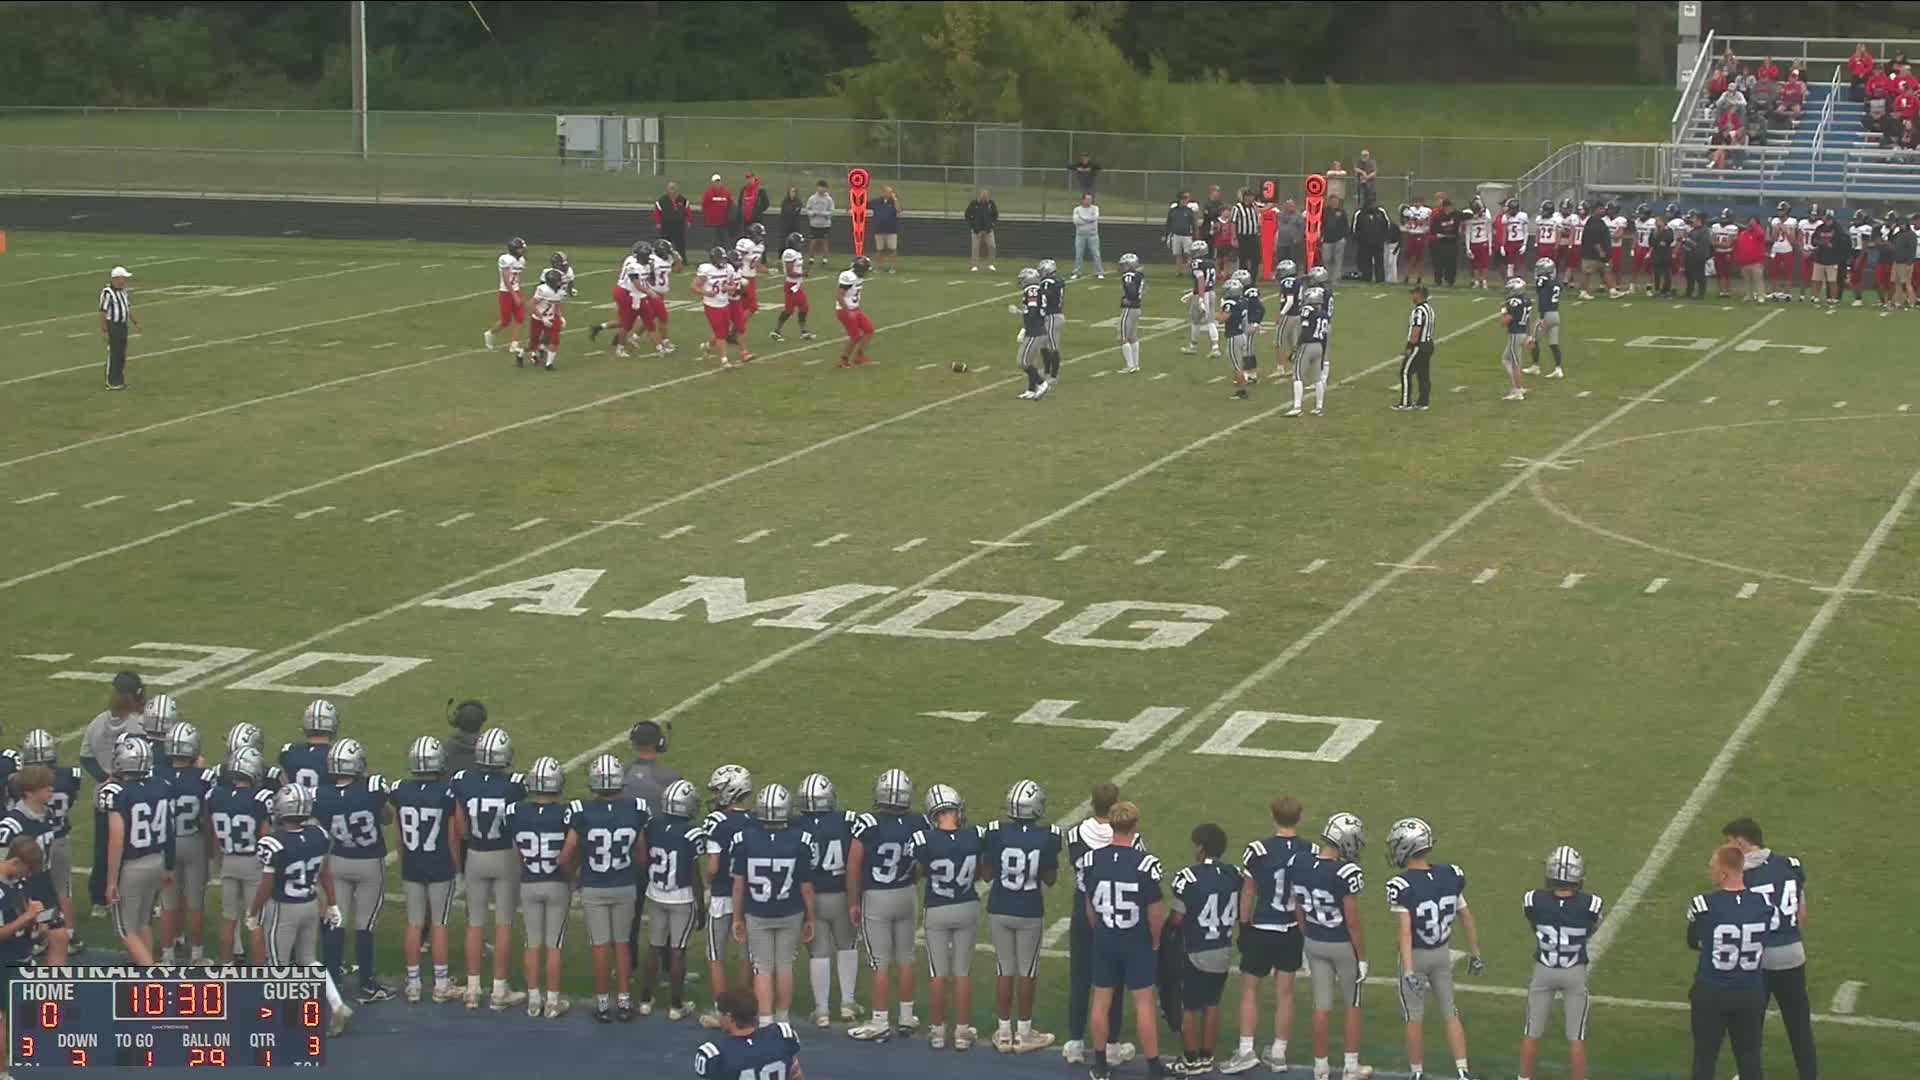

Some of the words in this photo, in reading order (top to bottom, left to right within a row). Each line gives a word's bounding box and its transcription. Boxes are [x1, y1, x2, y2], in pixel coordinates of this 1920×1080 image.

[1263, 181, 1275, 199] 3
[1511, 224, 1518, 238] 5
[423, 567, 1230, 650] AMDG
[48, 641, 433, 696] 30
[1013, 698, 1383, 764] 40
[130, 801, 168, 848] 64
[211, 812, 257, 856] 83
[331, 810, 377, 848] 43
[399, 806, 443, 851] 87
[466, 797, 506, 840] 17
[515, 830, 565, 874] 25
[588, 827, 637, 872] 33
[648, 846, 678, 890] 21
[1001, 847, 1041, 891] 81
[747, 858, 797, 903] 57
[930, 854, 977, 899] 24
[1092, 880, 1140, 930] 45
[1197, 891, 1238, 940] 44
[1416, 895, 1458, 945] 32
[1536, 924, 1587, 968] 85
[1711, 922, 1766, 971] 65
